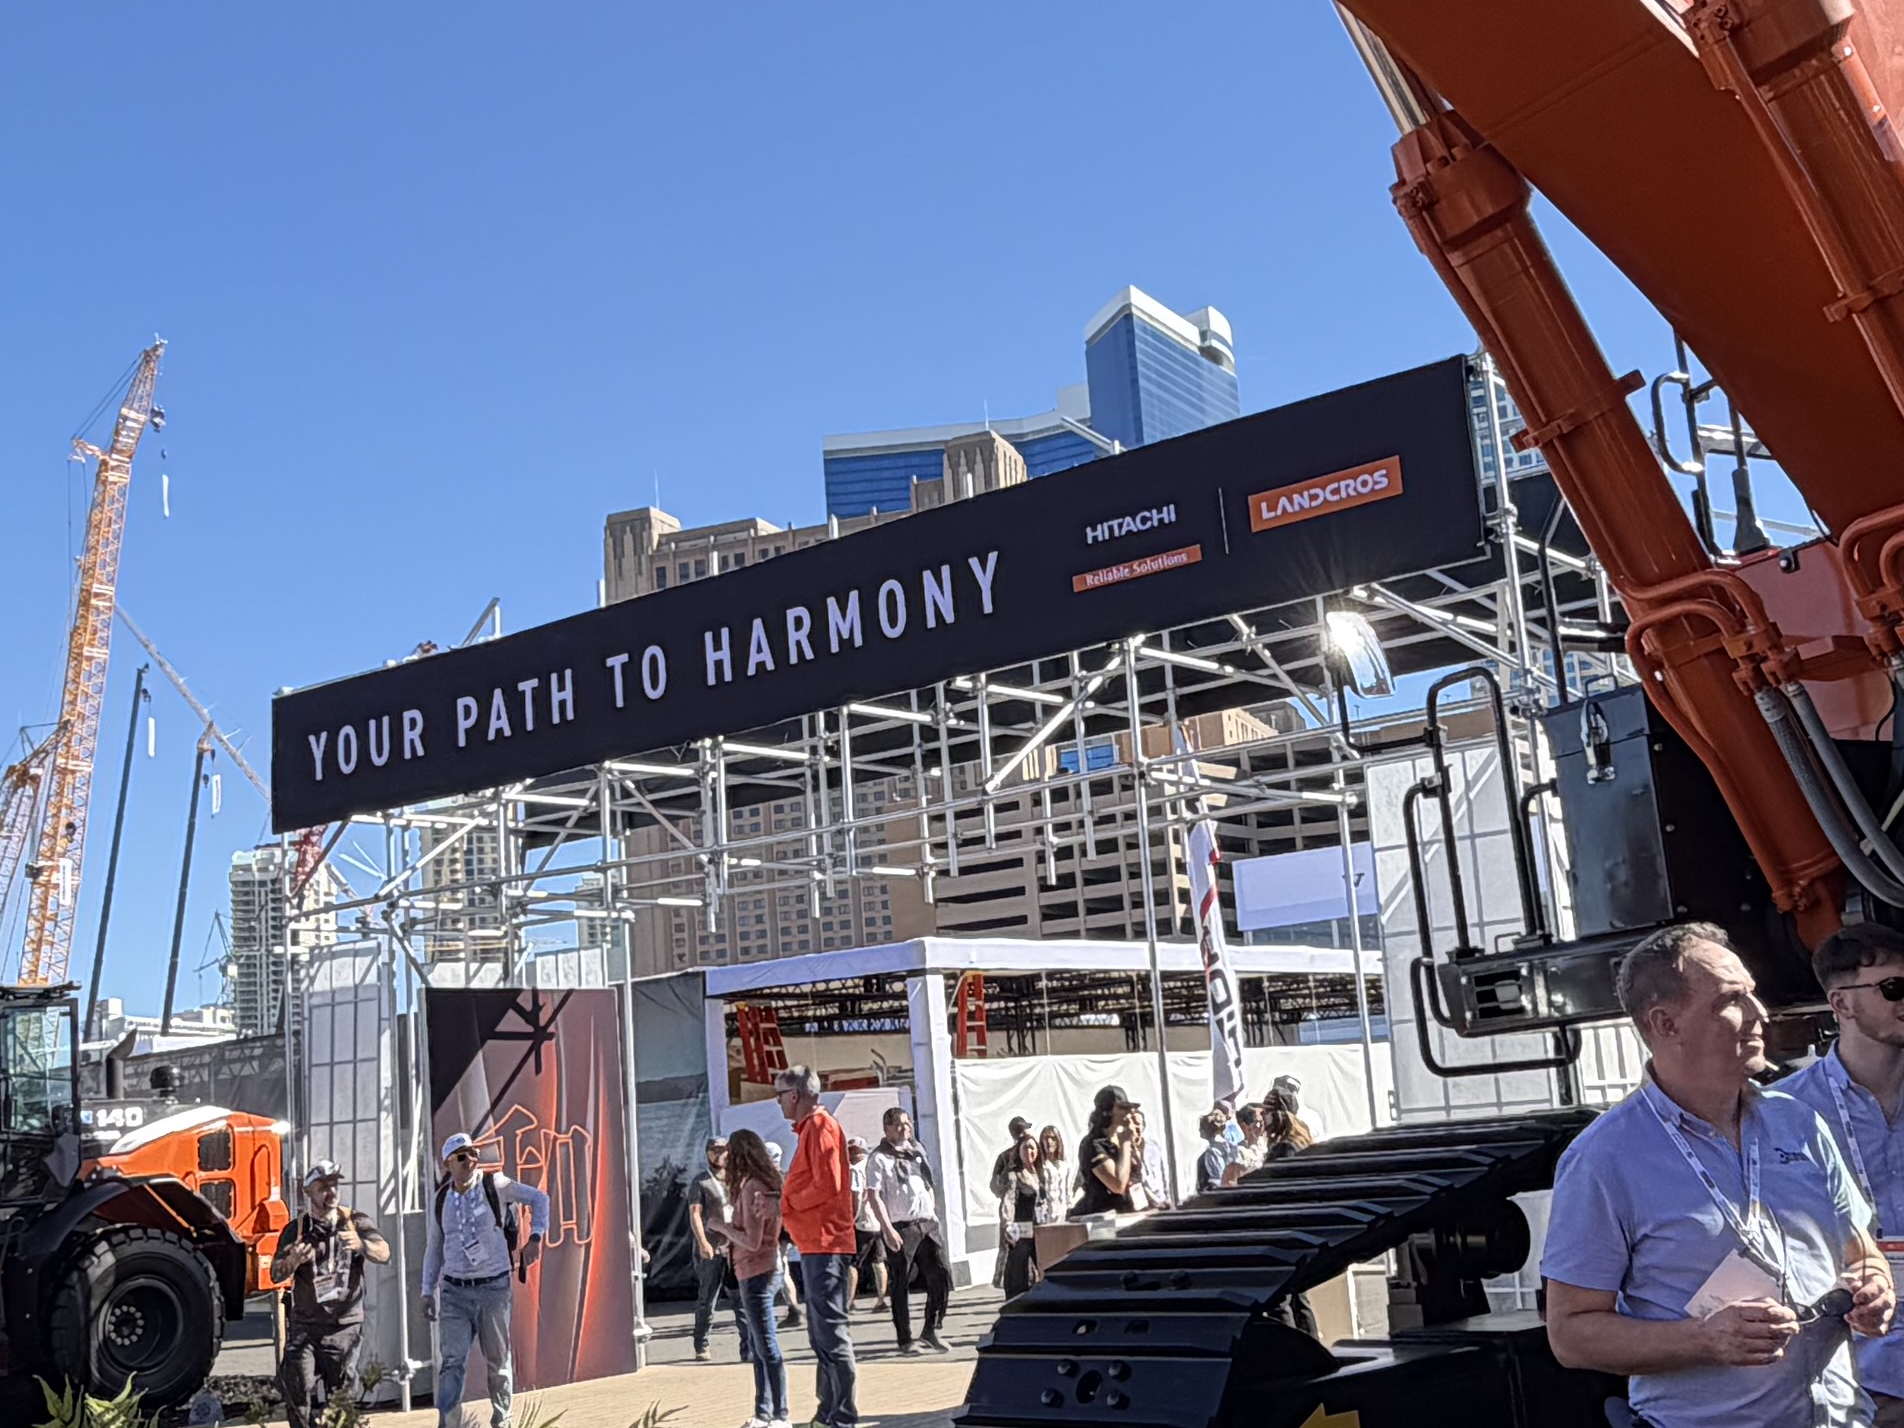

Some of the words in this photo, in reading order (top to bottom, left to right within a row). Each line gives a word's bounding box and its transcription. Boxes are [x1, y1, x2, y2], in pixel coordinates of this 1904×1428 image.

[1260, 469, 1389, 520] LANDCROS
[1086, 503, 1177, 545] HITACHI
[1085, 564, 1131, 587] Reliable
[1133, 551, 1189, 575] Solutions
[308, 708, 427, 781] YOUR
[456, 668, 576, 748] PATH
[605, 644, 667, 709] TO
[704, 549, 1002, 686] HARMONY
